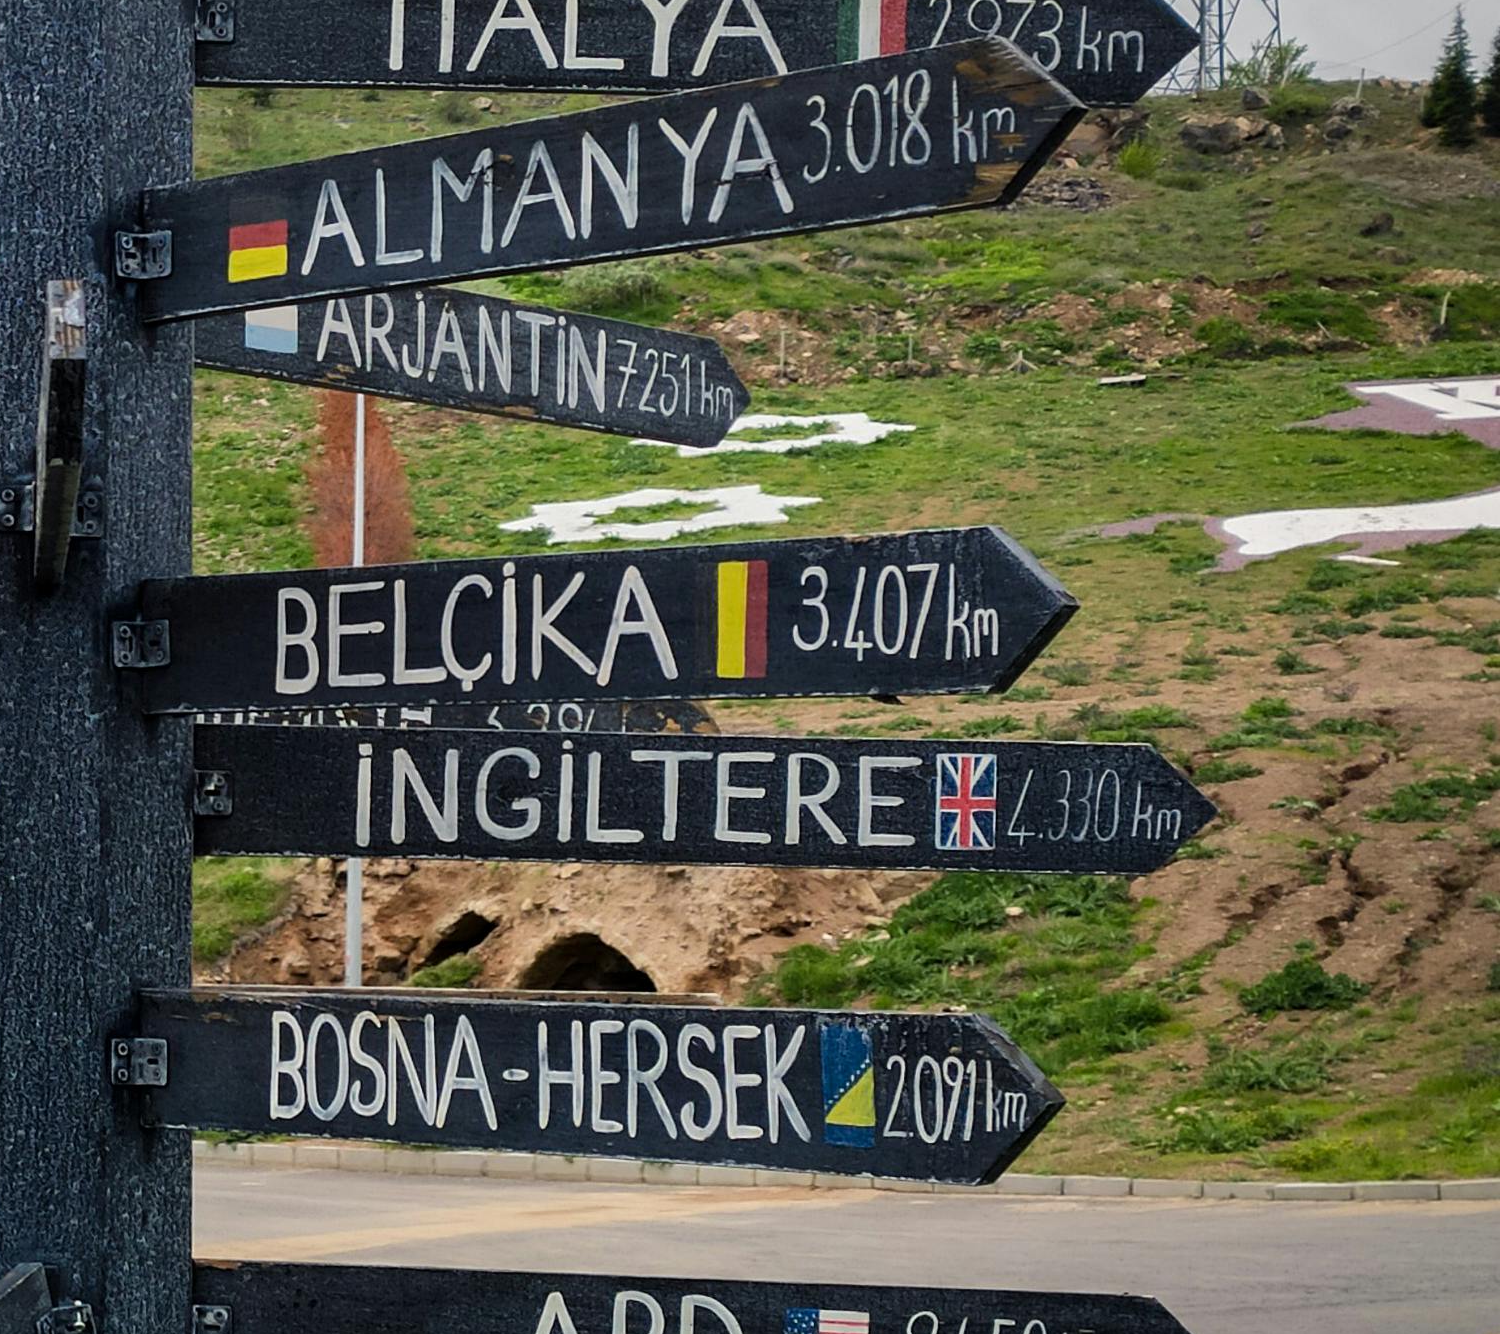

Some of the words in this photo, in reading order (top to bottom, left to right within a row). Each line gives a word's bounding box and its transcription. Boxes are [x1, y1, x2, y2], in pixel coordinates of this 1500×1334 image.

[1077, 6, 1144, 73] km
[302, 103, 793, 275] ALMANYA
[803, 69, 932, 184] 3.018
[953, 76, 1015, 164] km
[317, 291, 606, 413] ARJANTİN
[700, 359, 734, 420] km
[275, 563, 677, 695] BELÇİKA
[792, 563, 940, 662] 3.407
[945, 563, 999, 660] km
[356, 739, 923, 848] İNGİLTERE
[1007, 769, 1120, 846] 4.330
[1131, 781, 1182, 839] km
[269, 1009, 811, 1144] BOSNA-HERSEK
[883, 1055, 976, 1144] 2.091
[985, 1059, 1027, 1132] km
